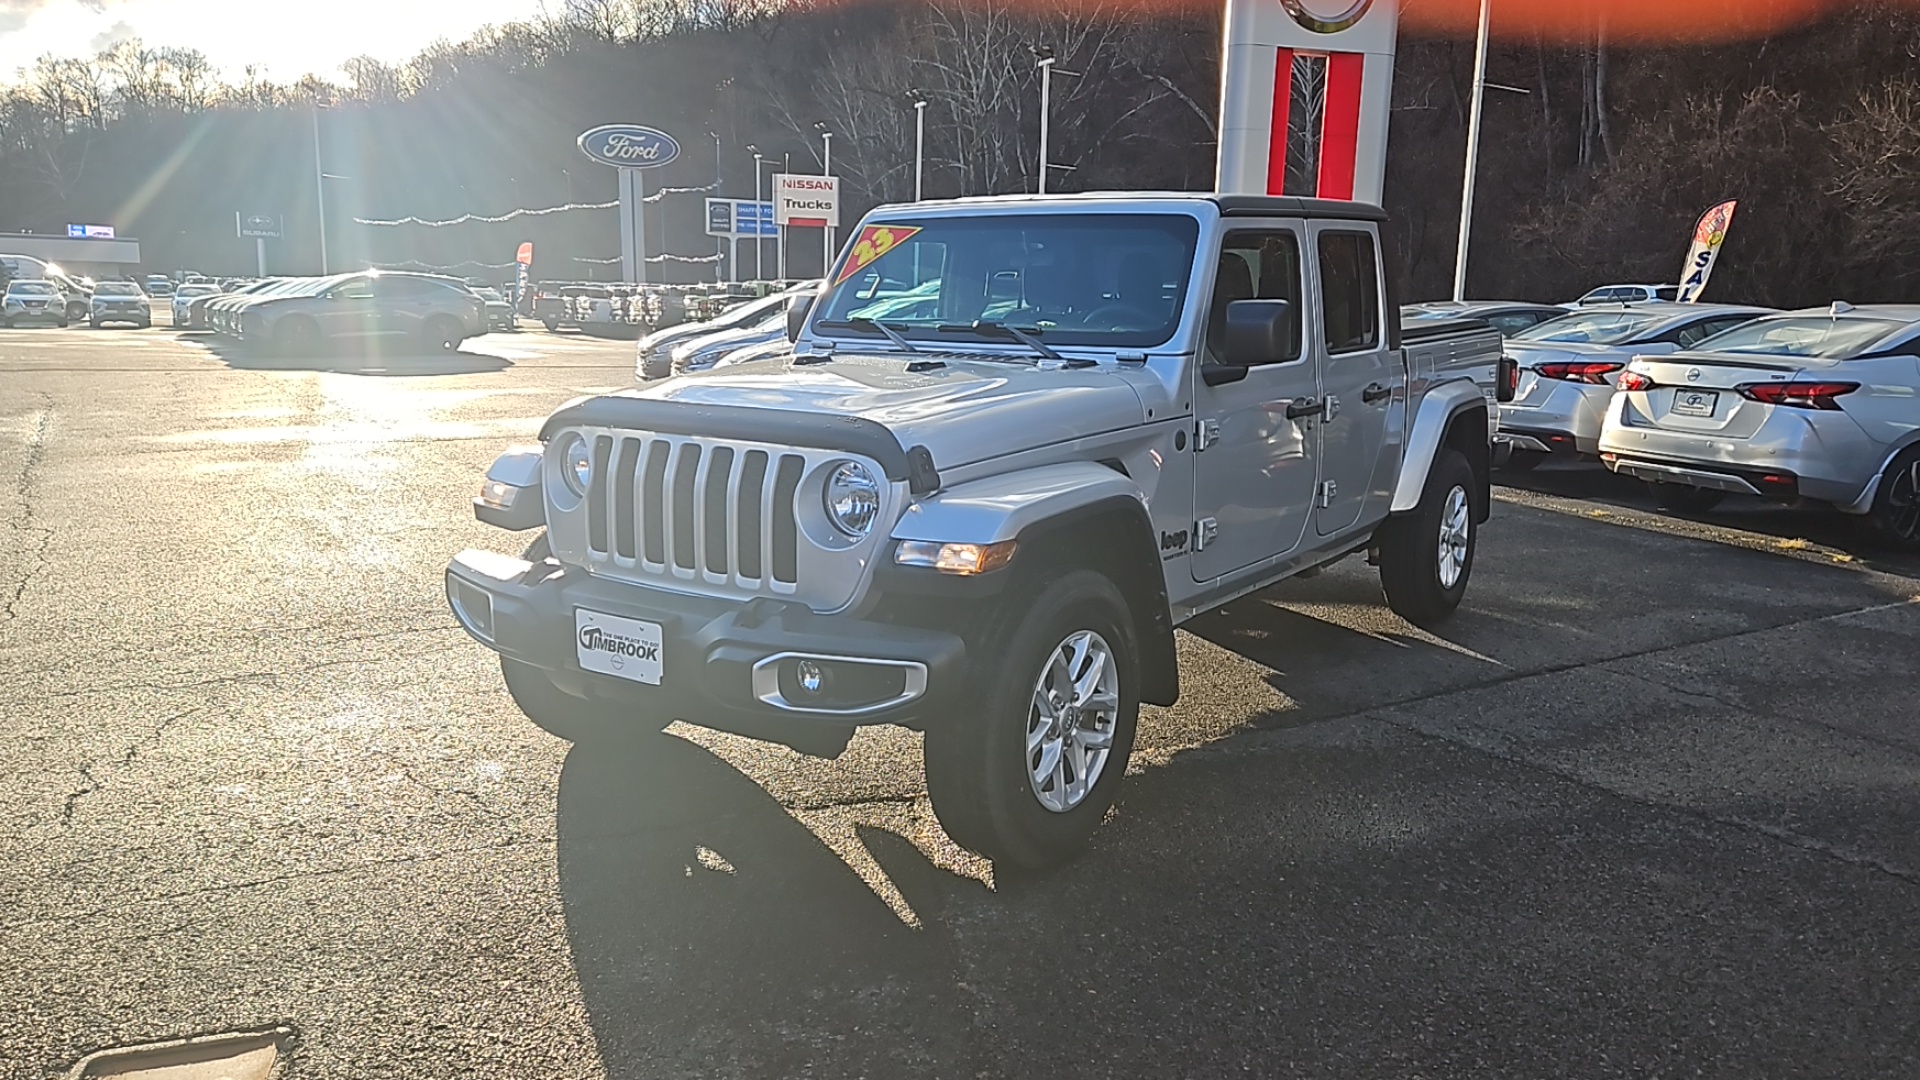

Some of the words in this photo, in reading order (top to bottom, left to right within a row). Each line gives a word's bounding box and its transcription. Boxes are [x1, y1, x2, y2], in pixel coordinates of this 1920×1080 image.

[603, 133, 660, 159] Ford
[782, 179, 833, 191] NISSAN
[783, 198, 833, 210] Trucks
[853, 227, 895, 266] 23
[1680, 251, 1711, 302] SAL
[579, 625, 659, 662] TIMBROOK
